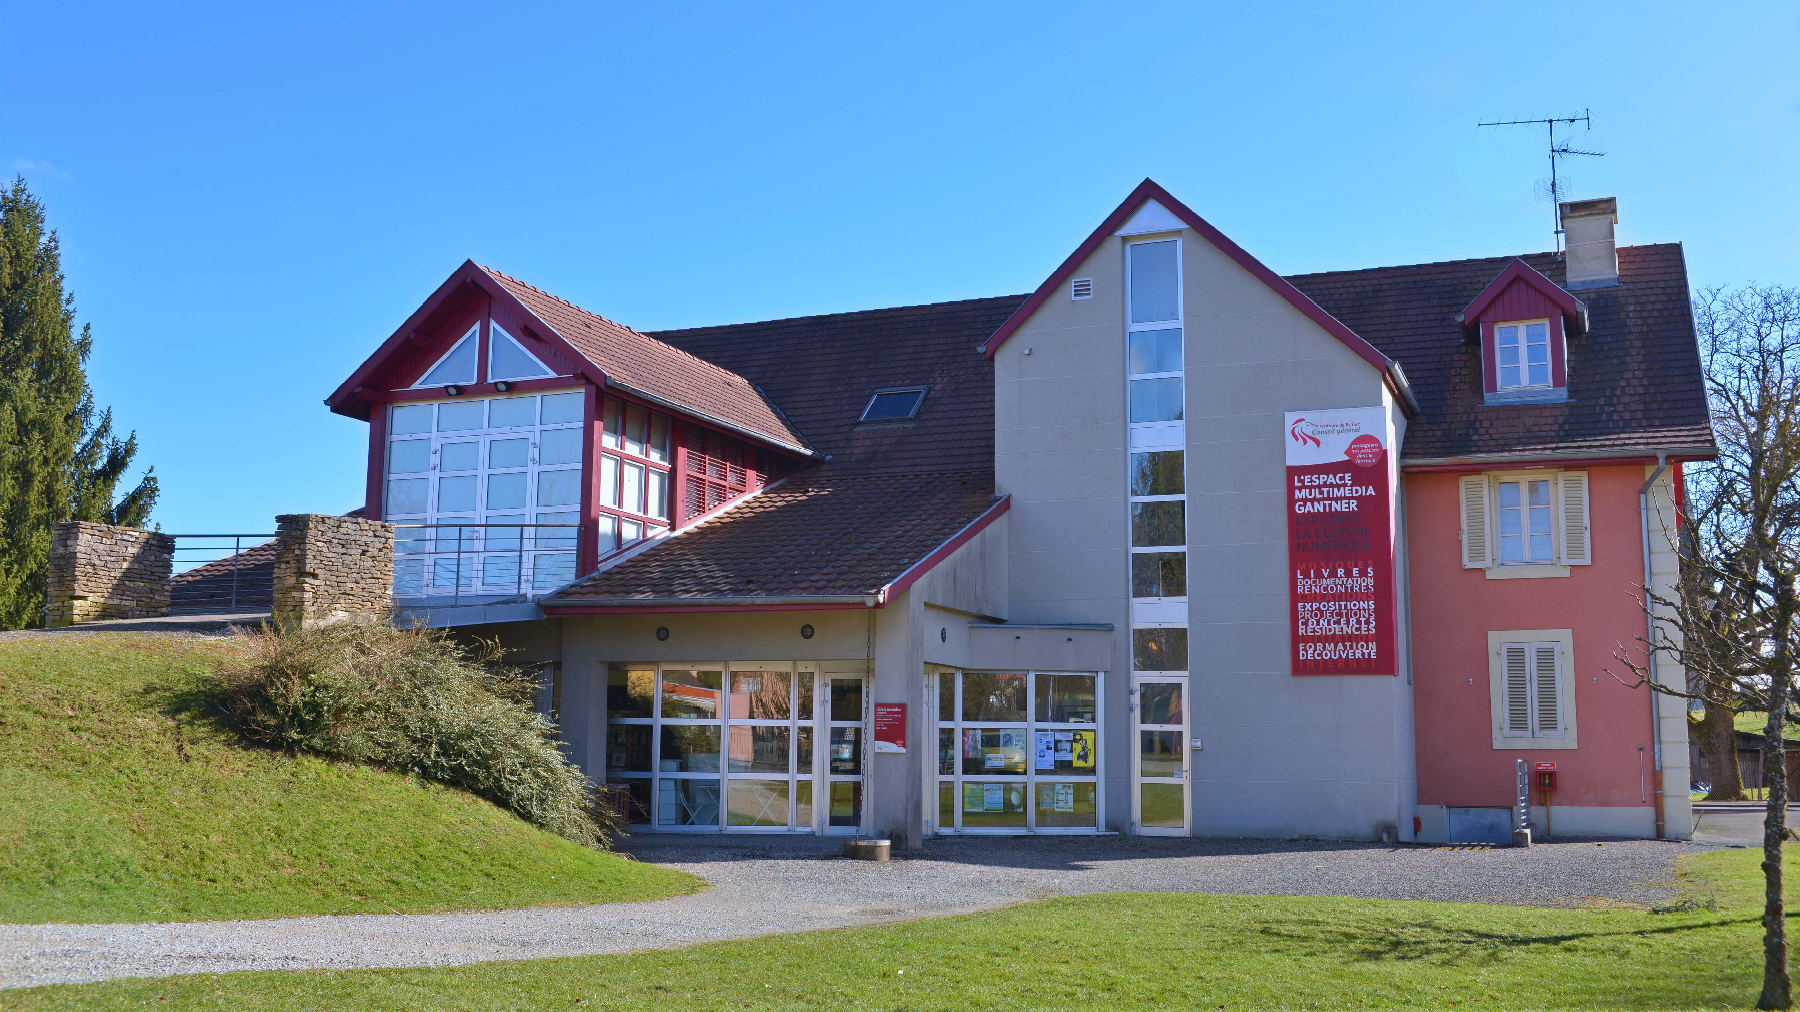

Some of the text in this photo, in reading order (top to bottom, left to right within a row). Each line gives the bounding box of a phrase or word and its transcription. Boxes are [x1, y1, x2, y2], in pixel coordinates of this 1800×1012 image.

[1311, 426, 1361, 435] Conseil général
[1294, 473, 1352, 487] L'ESPACE
[1294, 485, 1376, 499] MULTIMÉDIA
[1295, 499, 1358, 514] GANTNER
[1296, 513, 1360, 526] EXPLORER
[1296, 526, 1371, 540] LA CULTURE
[1297, 560, 1374, 571] MUSIQUES
[1297, 567, 1374, 578] LIVRES
[1297, 577, 1375, 586] DOCUMENTATION
[1297, 584, 1375, 594] RENCONTRES
[1298, 601, 1375, 611] EXPOSITIONS
[1298, 609, 1376, 620] PROJECTIONS
[1298, 617, 1376, 627] CONCERTS
[1299, 634, 1377, 643] INITIATION
[1299, 642, 1377, 651] FORMATION
[1299, 659, 1377, 668] INTERNET
